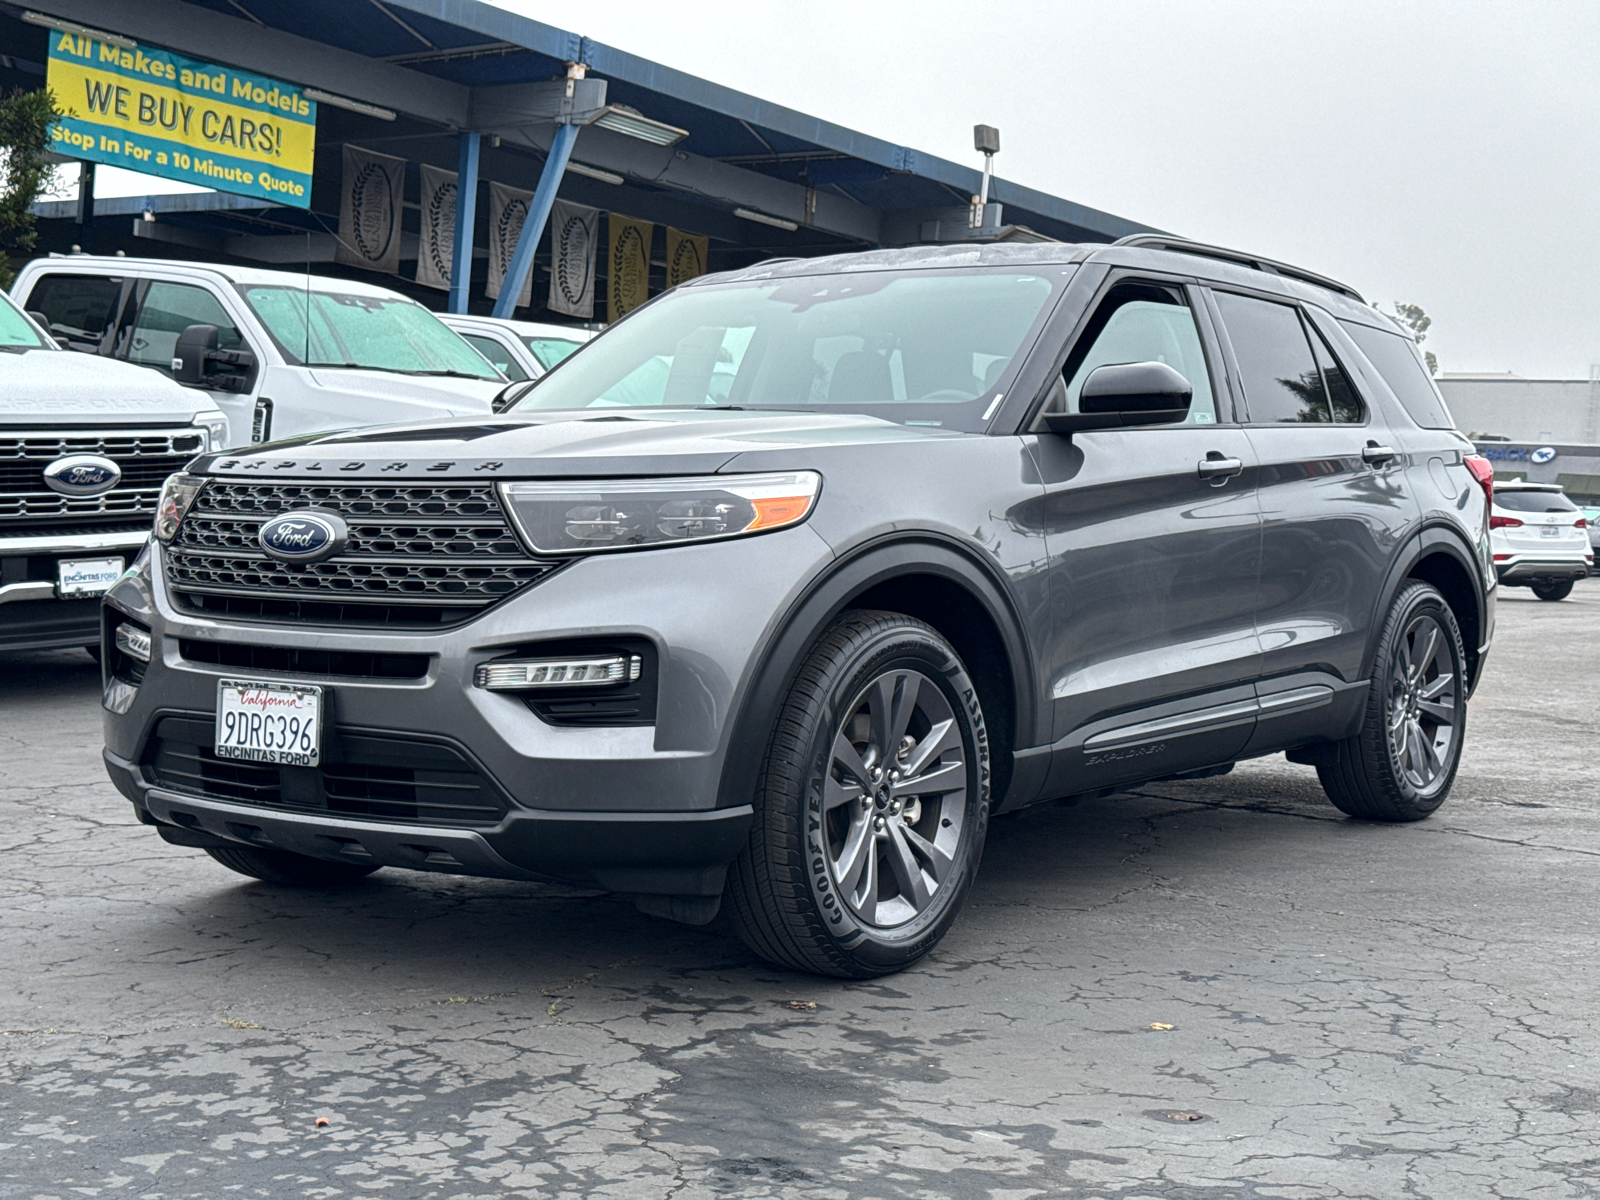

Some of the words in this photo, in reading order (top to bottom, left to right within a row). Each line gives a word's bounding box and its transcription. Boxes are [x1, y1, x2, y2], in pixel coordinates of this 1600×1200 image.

[57, 33, 92, 59] All
[99, 41, 176, 80] Makes
[180, 69, 226, 95] and
[232, 77, 310, 116] Models
[85, 78, 130, 119] WE
[138, 92, 194, 134] BUY
[202, 109, 282, 157] CARS!
[51, 126, 95, 152] Stop
[100, 135, 120, 154] In
[124, 141, 152, 161] For
[156, 150, 169, 165] a
[172, 152, 191, 171] 10
[194, 157, 254, 184] Minute
[258, 172, 305, 197] Quote
[69, 467, 105, 484] Ford
[219, 460, 503, 472] EXPLORER
[273, 523, 315, 547] Ford
[101, 572, 118, 580] FORD
[240, 689, 303, 711] California
[224, 711, 313, 752] 9DRG396
[217, 745, 276, 762] ENCINITAS
[280, 752, 310, 766] FORD
[962, 687, 989, 834] ASSURANCE
[803, 752, 843, 926] GOODYEAR
